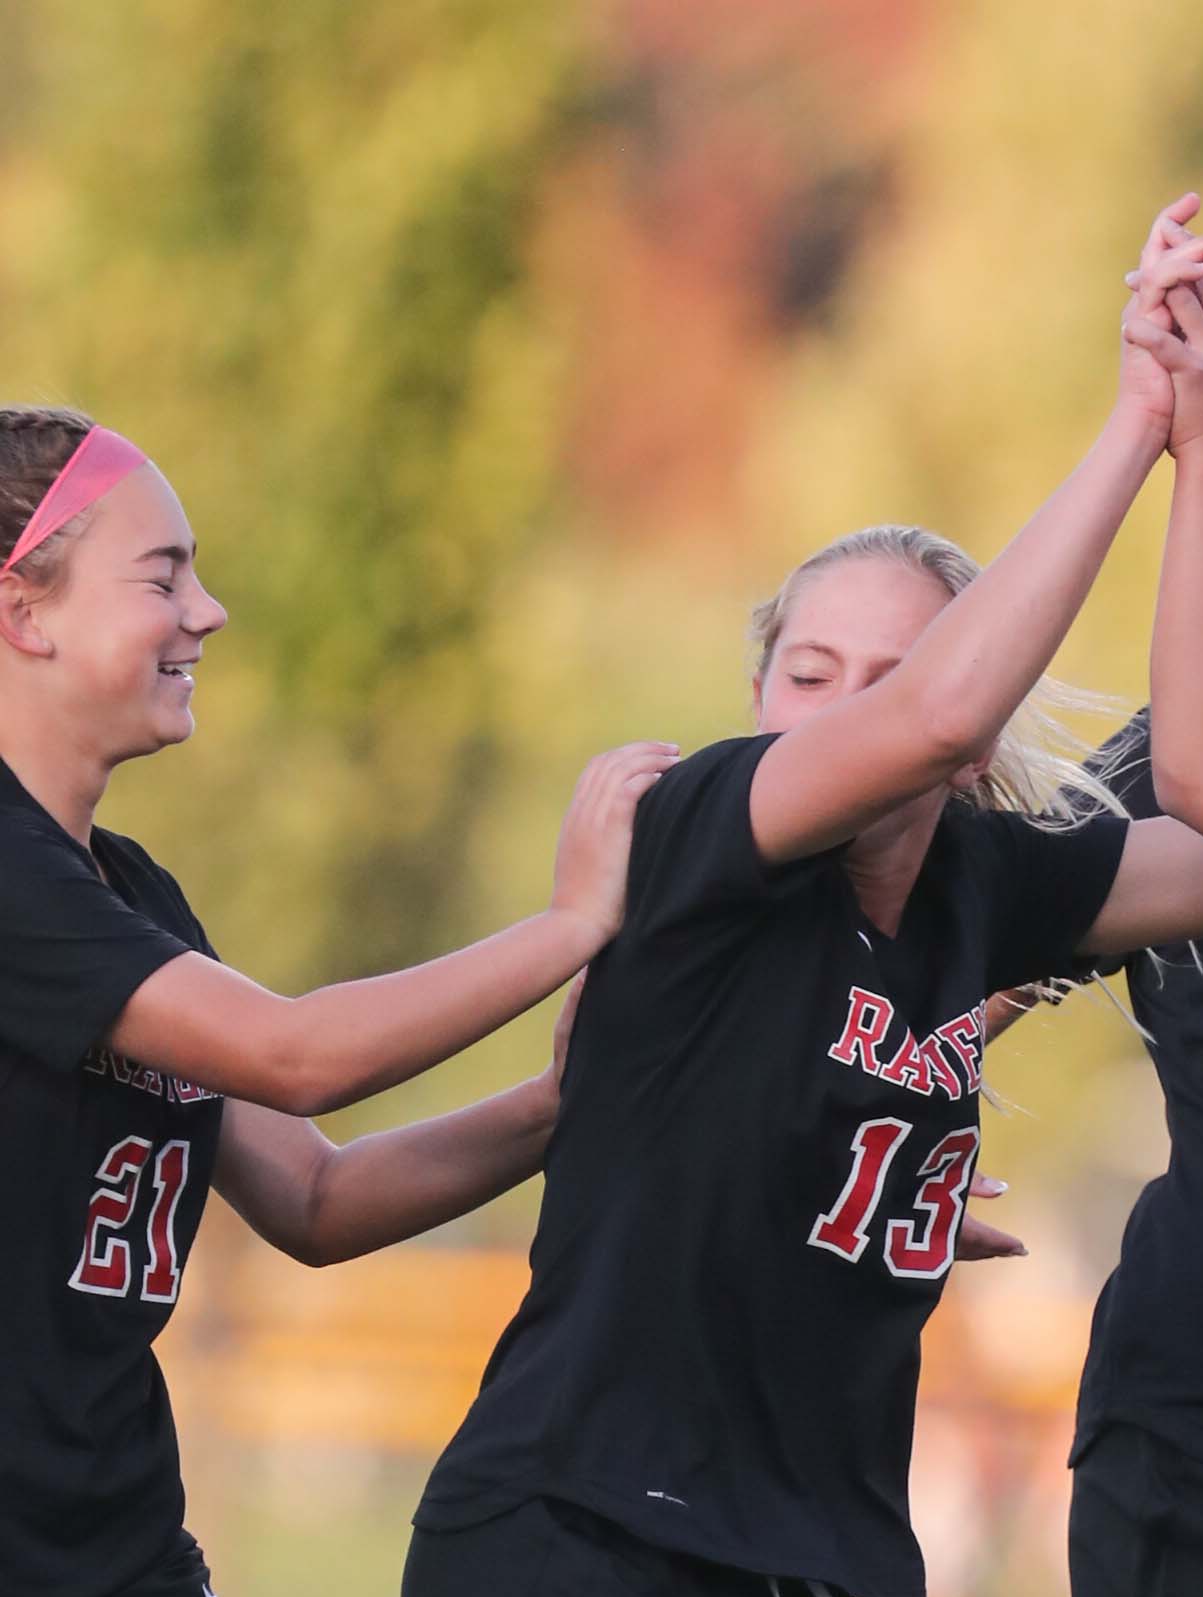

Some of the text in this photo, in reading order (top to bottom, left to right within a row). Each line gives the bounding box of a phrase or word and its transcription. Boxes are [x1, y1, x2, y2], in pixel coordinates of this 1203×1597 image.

[828, 986, 986, 1101] RAVE
[67, 1135, 190, 1303] 21
[806, 1117, 980, 1280] 13
